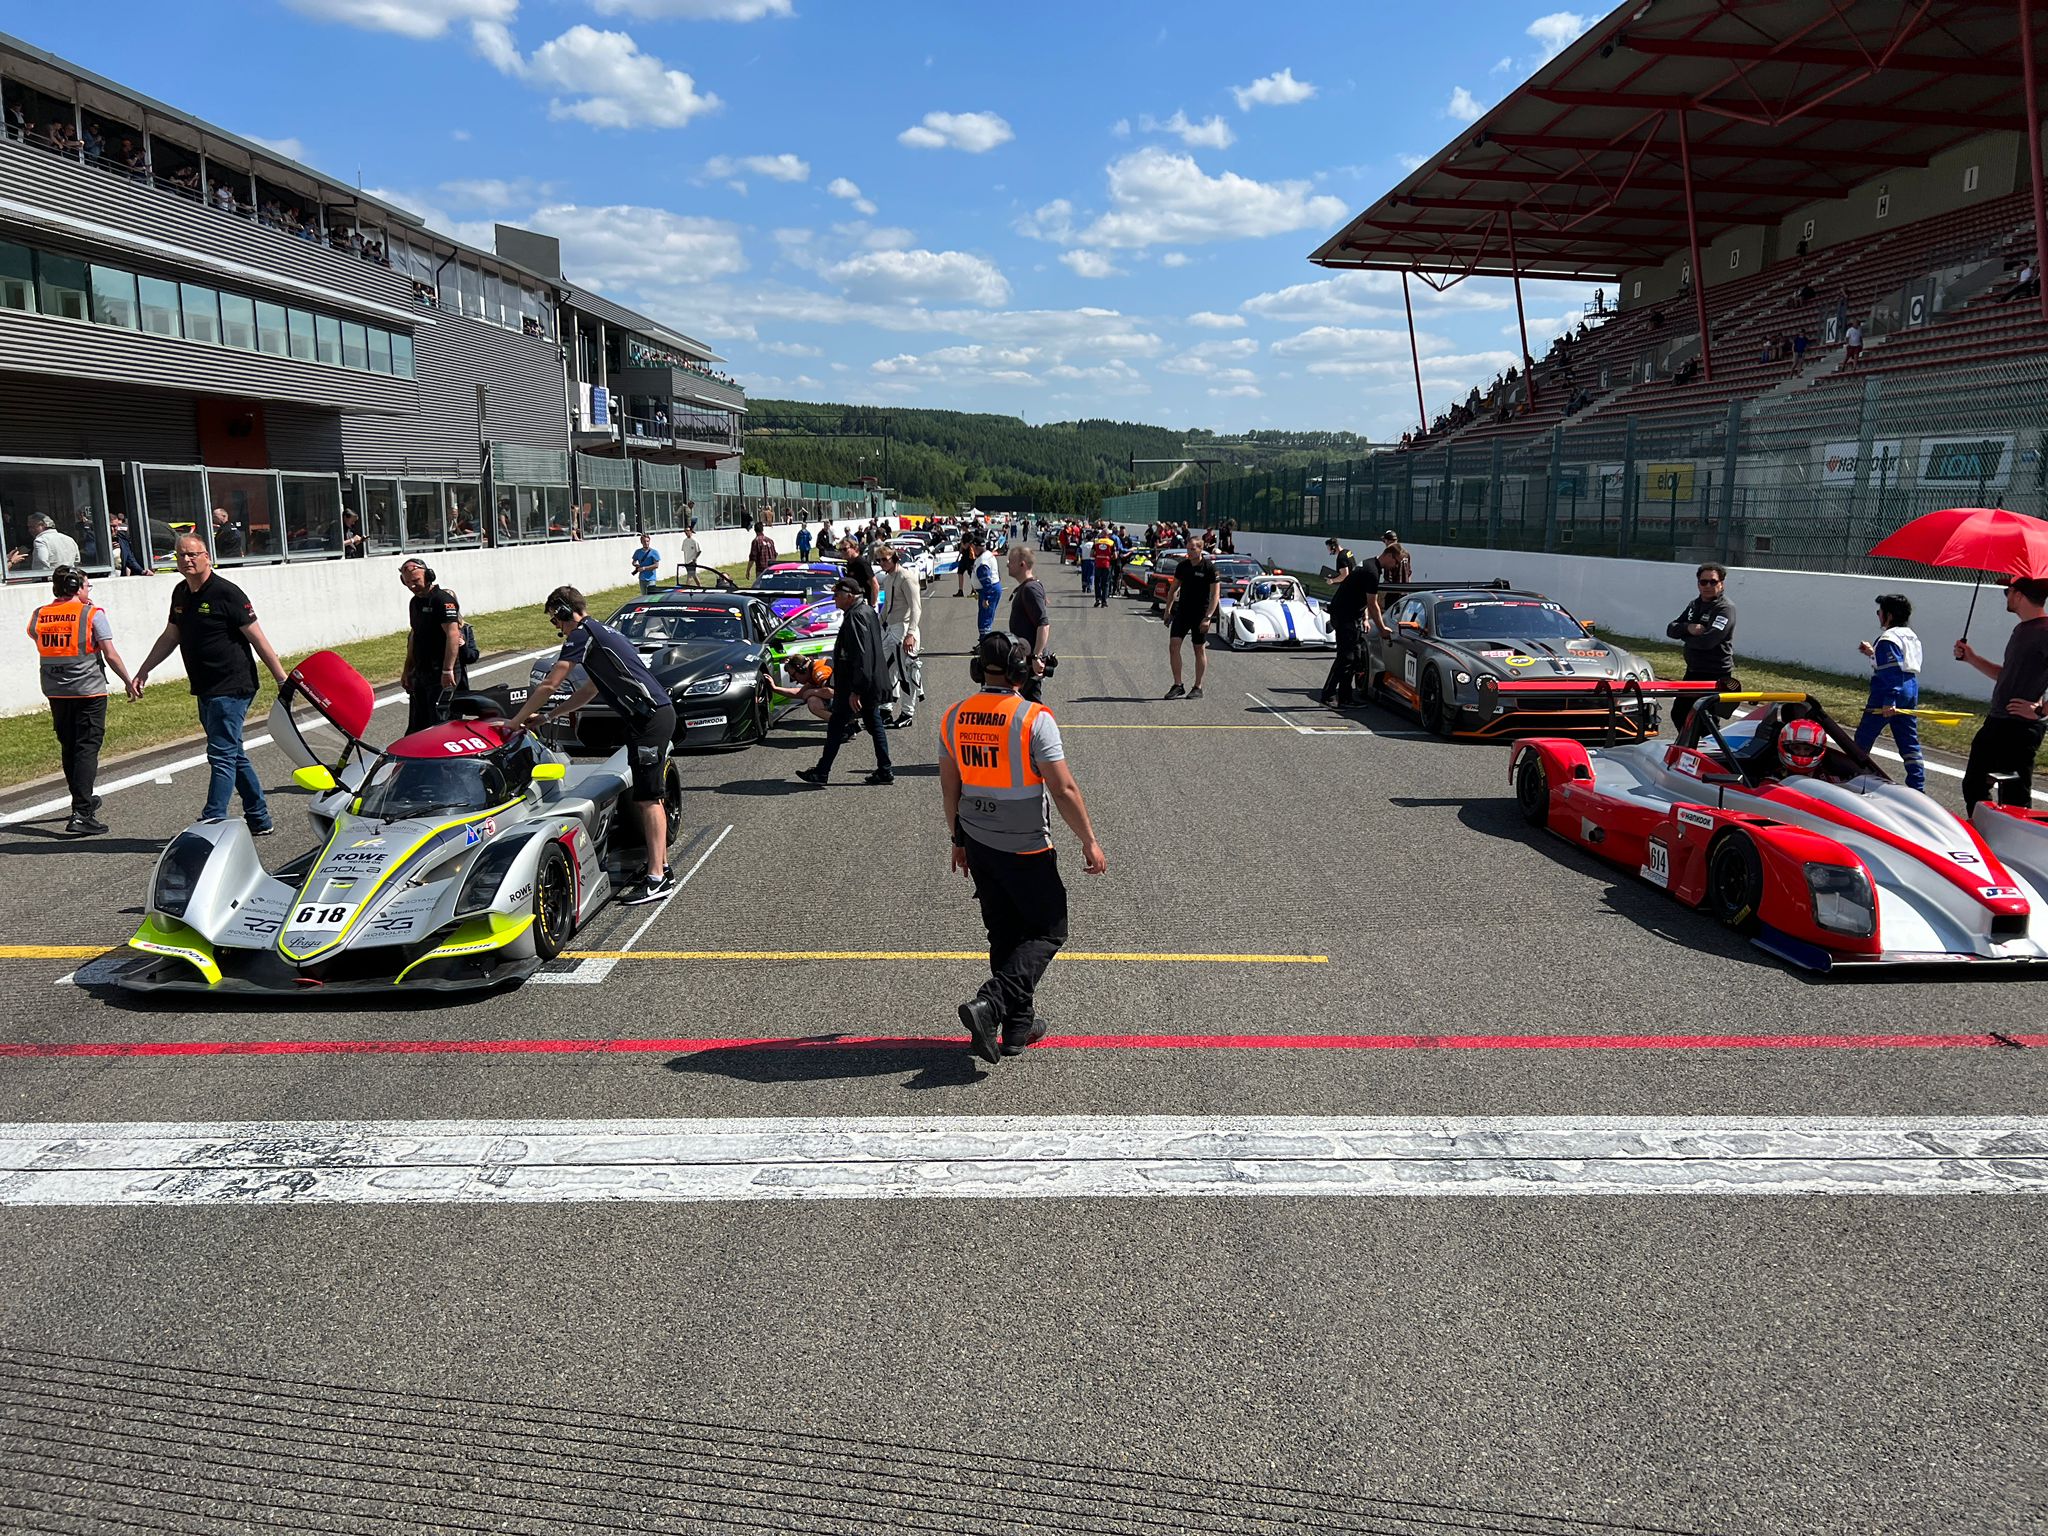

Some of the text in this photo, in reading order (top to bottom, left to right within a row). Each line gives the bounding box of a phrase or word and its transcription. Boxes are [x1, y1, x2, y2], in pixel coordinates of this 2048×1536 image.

[1828, 320, 1836, 341] K
[40, 614, 76, 624] STEWARD
[958, 711, 1007, 727] STEWARD
[959, 732, 1000, 742] PROTECTION
[443, 737, 488, 753] 618
[975, 799, 997, 813] 919
[332, 853, 389, 862] ROWE
[1651, 847, 1666, 873] 614
[509, 883, 532, 903] ROWE
[296, 906, 347, 924] 618
[227, 929, 269, 939] RODOLFO
[364, 930, 411, 938] RODOLFO
